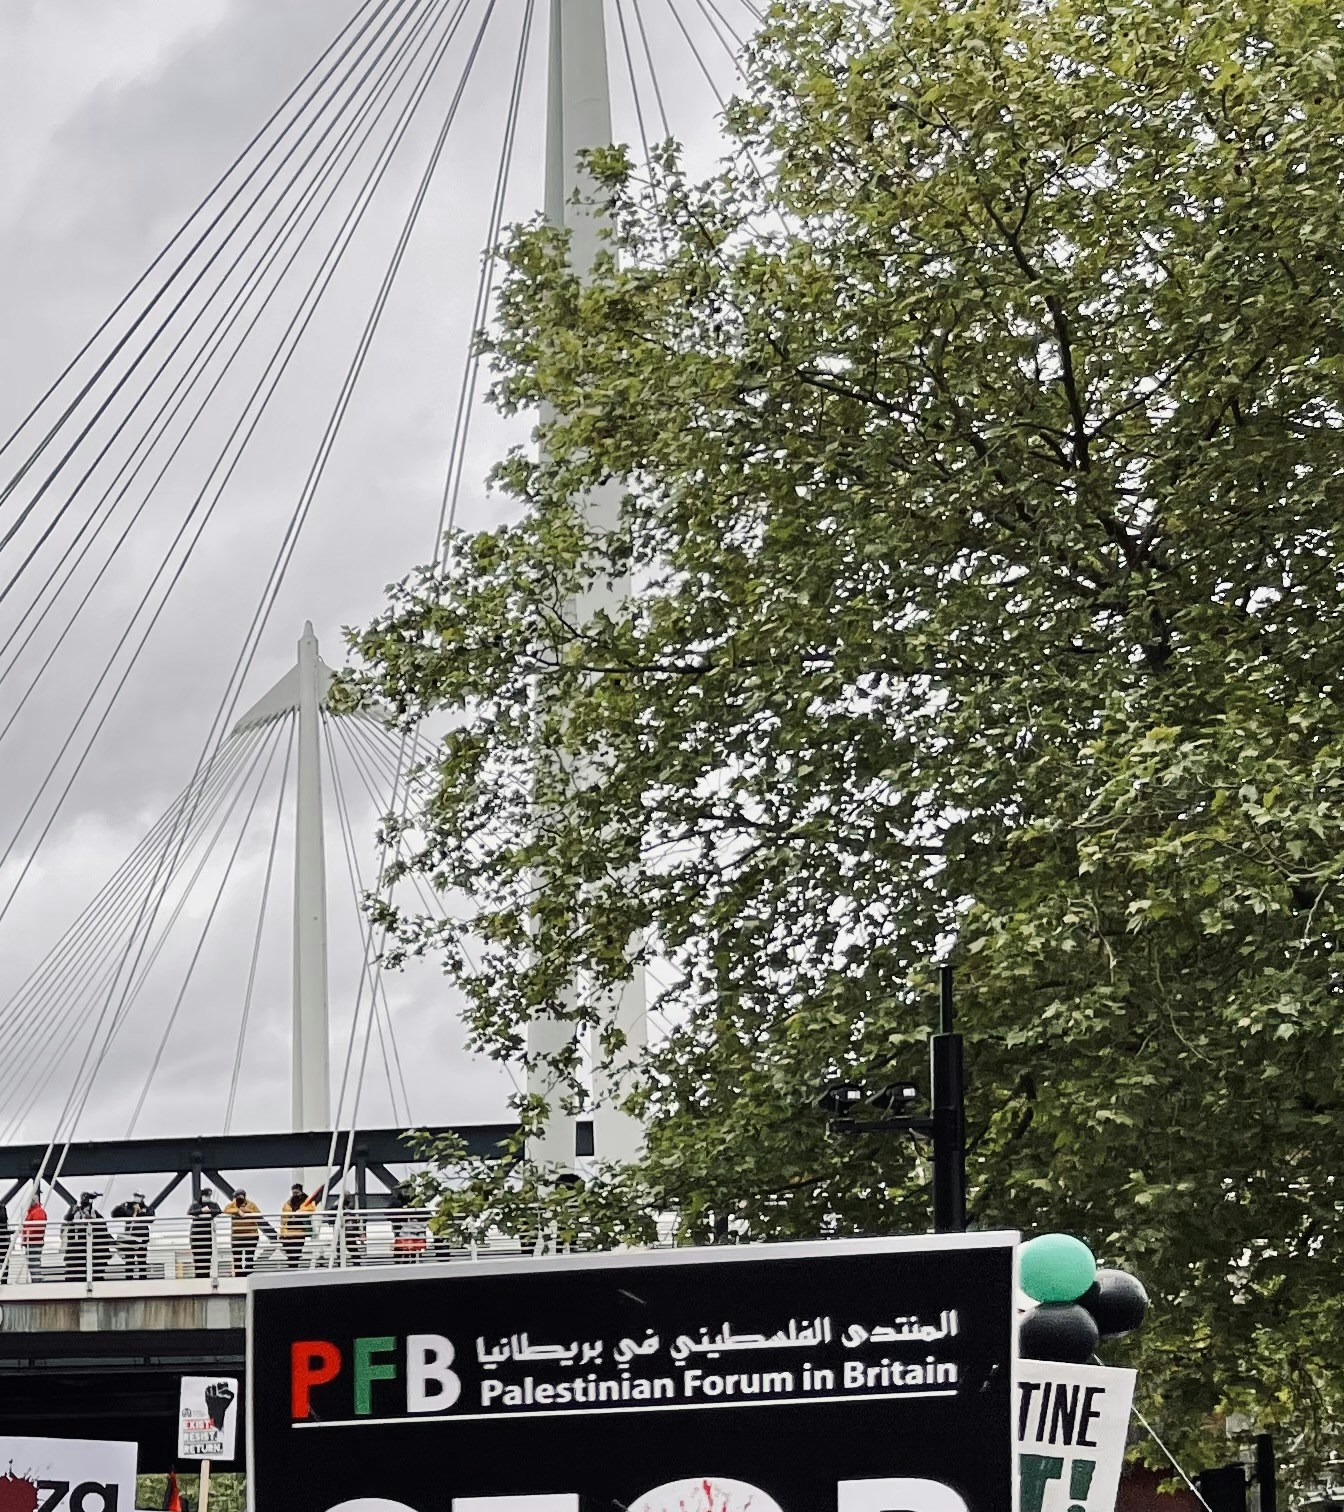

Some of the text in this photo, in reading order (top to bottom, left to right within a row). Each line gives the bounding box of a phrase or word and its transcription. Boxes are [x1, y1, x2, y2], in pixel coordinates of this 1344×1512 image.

[613, 1328, 660, 1370] في
[670, 1316, 833, 1367] الفلسطيني
[291, 1334, 462, 1418] PFB
[480, 1356, 958, 1407] Palestinian Forum in Britain
[1017, 1381, 1106, 1448] TINE
